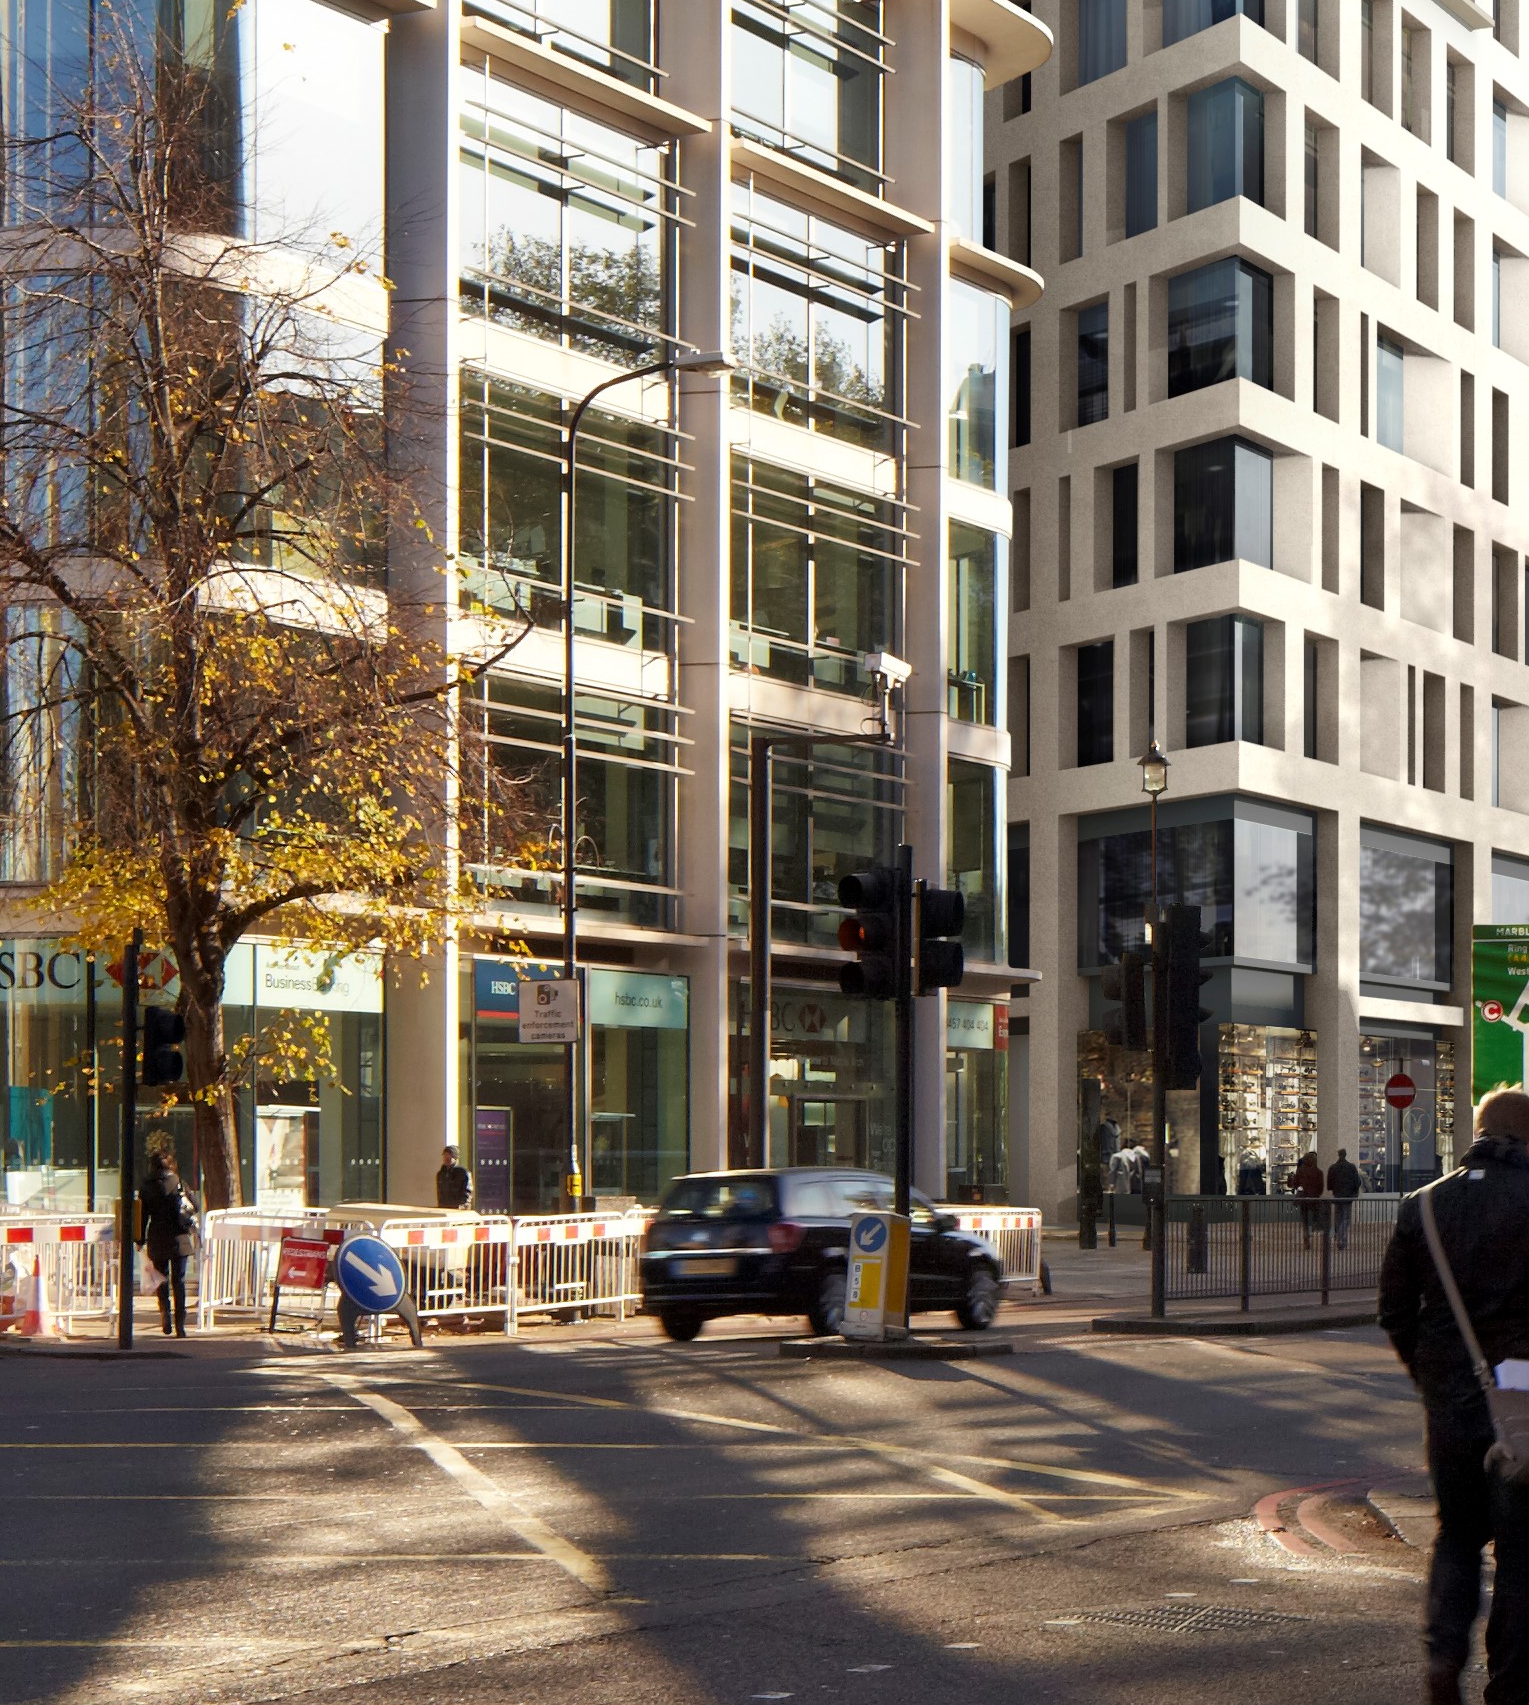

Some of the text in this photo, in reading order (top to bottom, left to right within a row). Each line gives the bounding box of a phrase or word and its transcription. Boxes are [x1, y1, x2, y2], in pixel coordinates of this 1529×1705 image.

[1507, 944, 1528, 954] Ring
[491, 980, 518, 996] HSBC
[614, 991, 664, 1010] hsbc.co.uk
[533, 1009, 563, 1018] Traffic
[521, 1020, 575, 1030] enforcement
[530, 1031, 567, 1040] cameras
